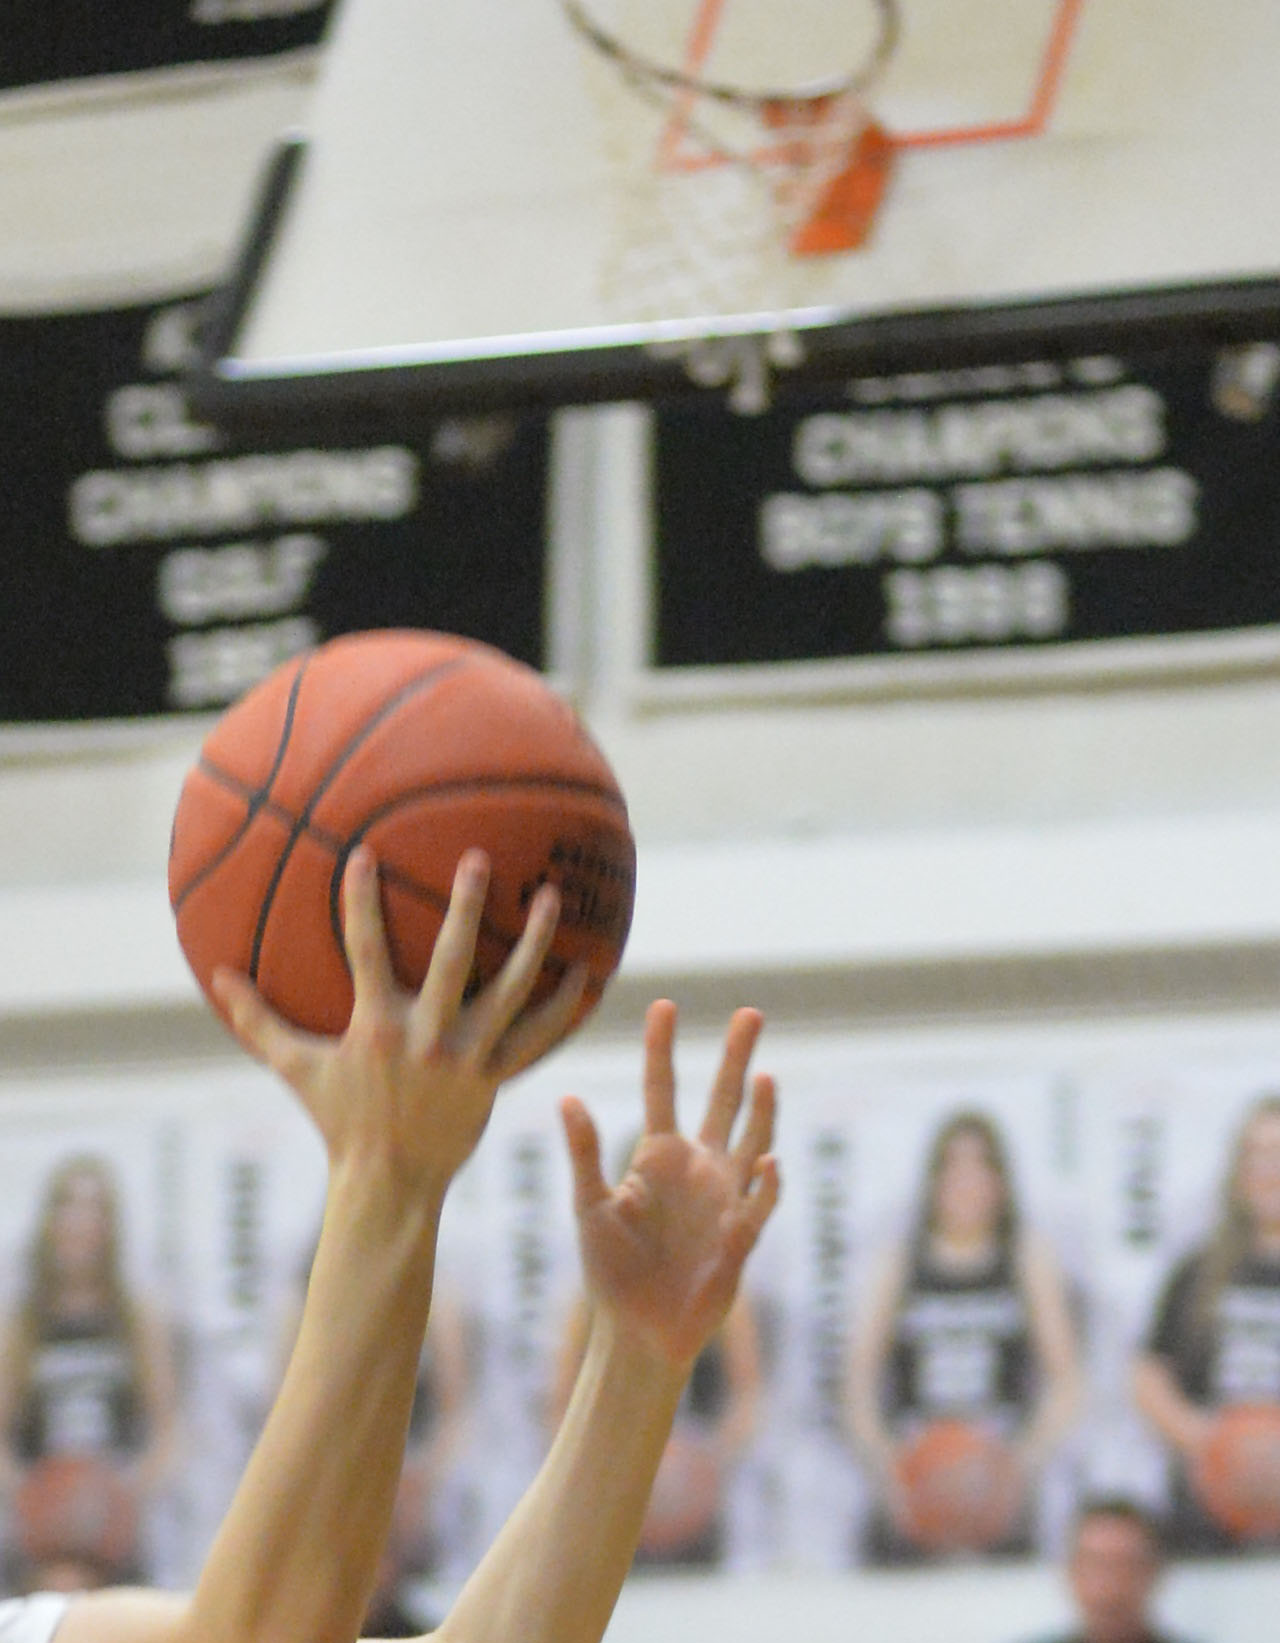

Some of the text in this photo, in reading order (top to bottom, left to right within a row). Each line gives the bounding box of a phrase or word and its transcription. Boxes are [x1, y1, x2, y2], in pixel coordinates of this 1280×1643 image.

[794, 384, 1166, 488] CHAMPIONS
[760, 466, 1196, 572] BOYS TENNIS
